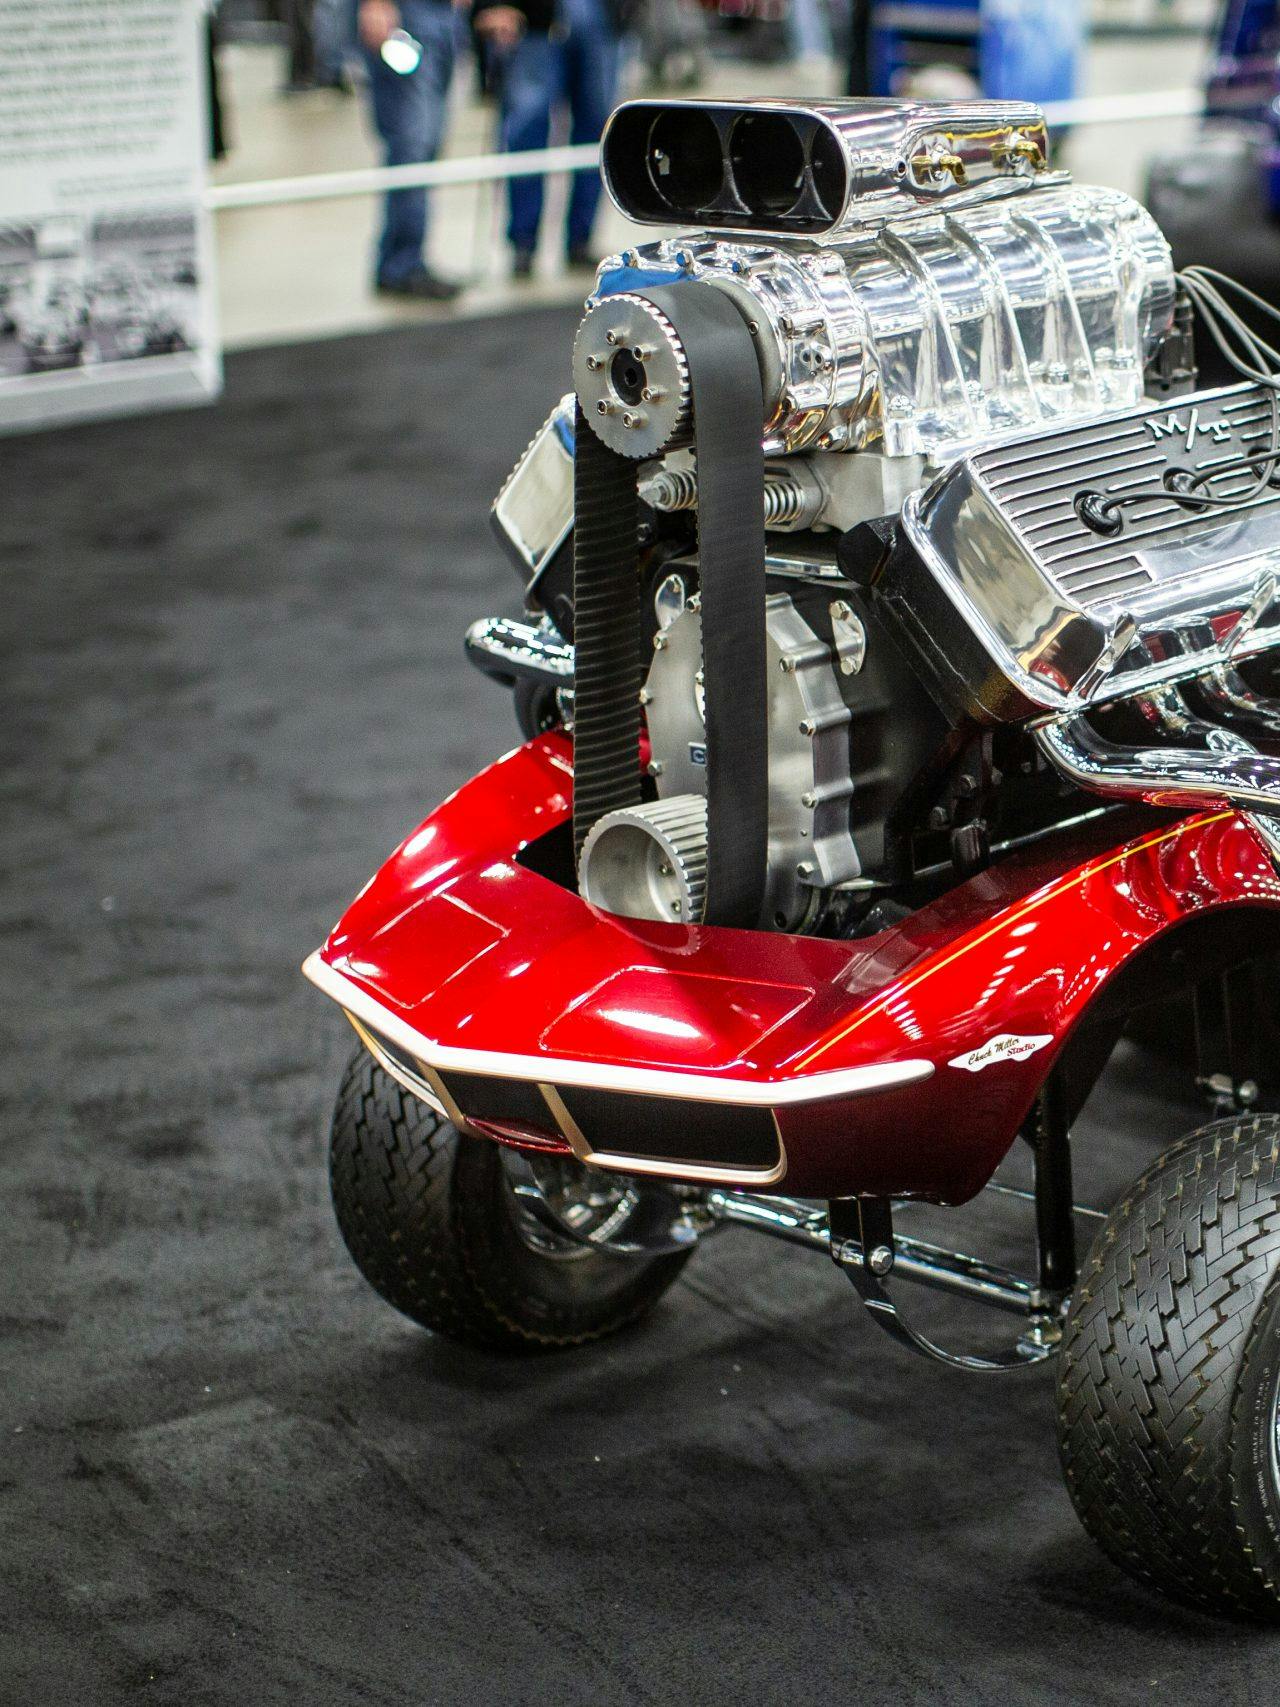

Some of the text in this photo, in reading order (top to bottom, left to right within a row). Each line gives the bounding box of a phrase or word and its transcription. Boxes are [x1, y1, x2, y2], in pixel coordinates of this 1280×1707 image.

[968, 1038, 1019, 1065] Chuck Miller
[1007, 1043, 1035, 1057] Studio
